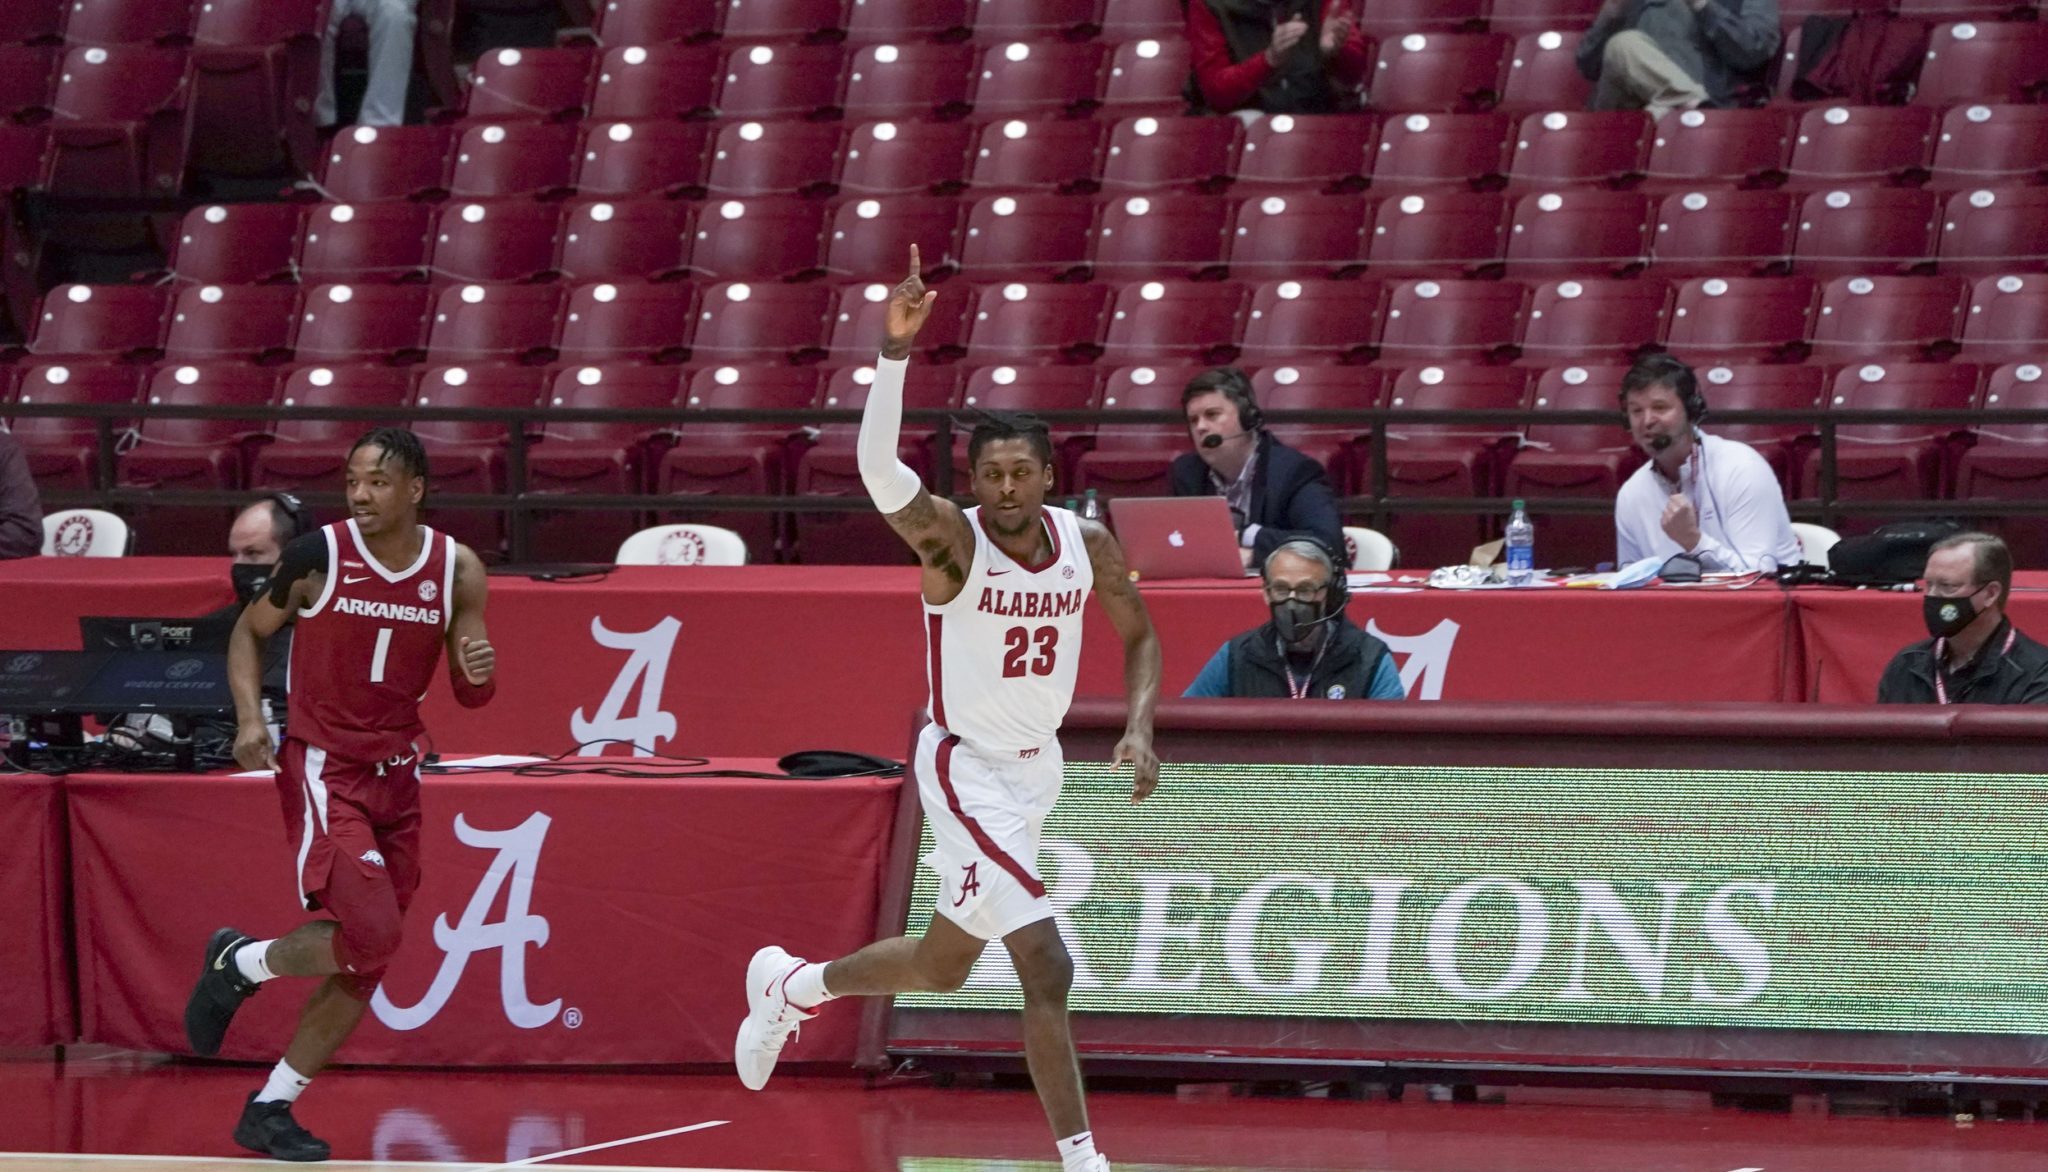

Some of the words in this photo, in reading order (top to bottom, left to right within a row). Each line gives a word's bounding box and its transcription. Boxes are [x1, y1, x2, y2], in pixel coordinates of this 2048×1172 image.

[333, 597, 441, 625] ARKANSAS
[977, 587, 1082, 618] ALABAMA
[370, 628, 393, 683] 1
[1002, 625, 1059, 678] 23
[570, 615, 683, 757] A
[952, 861, 981, 907] A
[369, 811, 563, 1031] A
